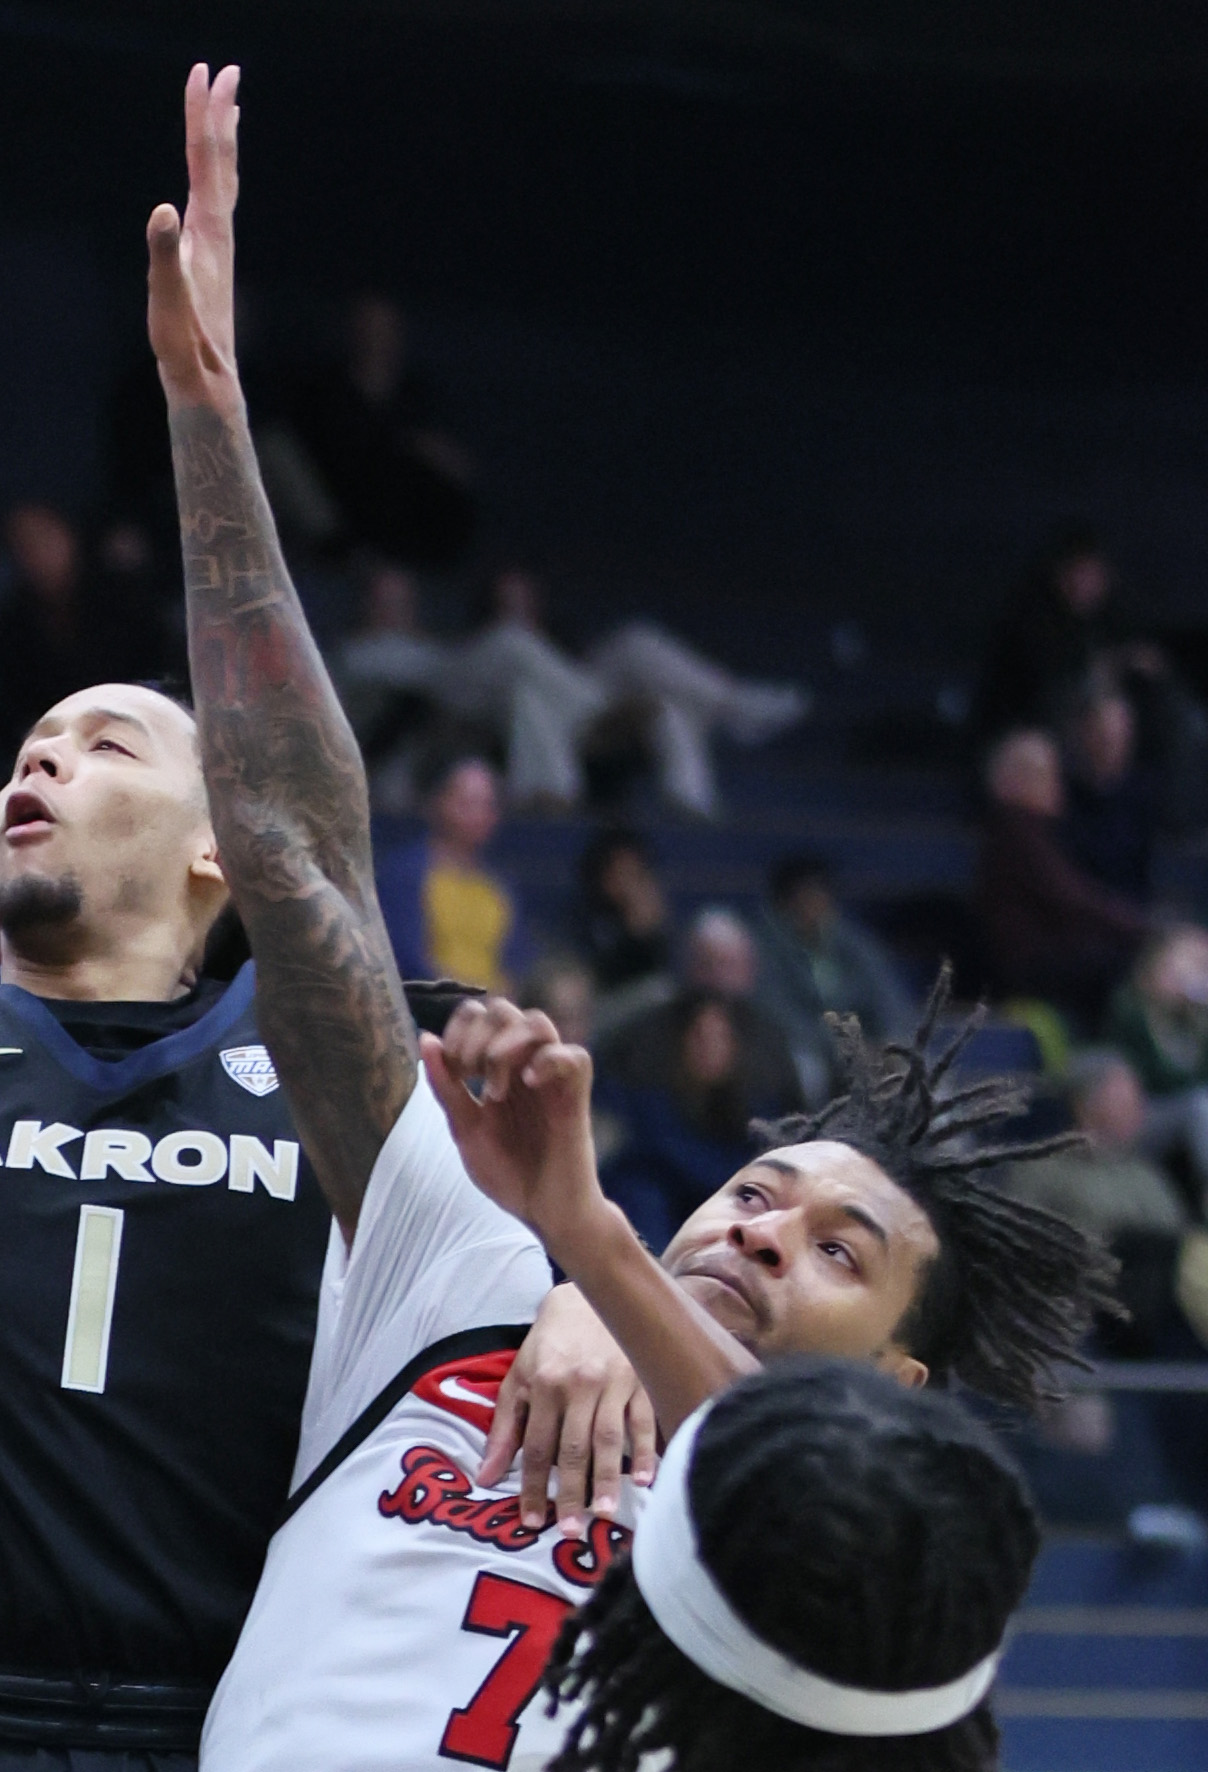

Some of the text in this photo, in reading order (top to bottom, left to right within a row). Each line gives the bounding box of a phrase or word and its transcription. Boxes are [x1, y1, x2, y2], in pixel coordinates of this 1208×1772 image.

[228, 1060, 276, 1074] MA
[60, 1203, 125, 1394] 1
[437, 1569, 577, 1771] 7
